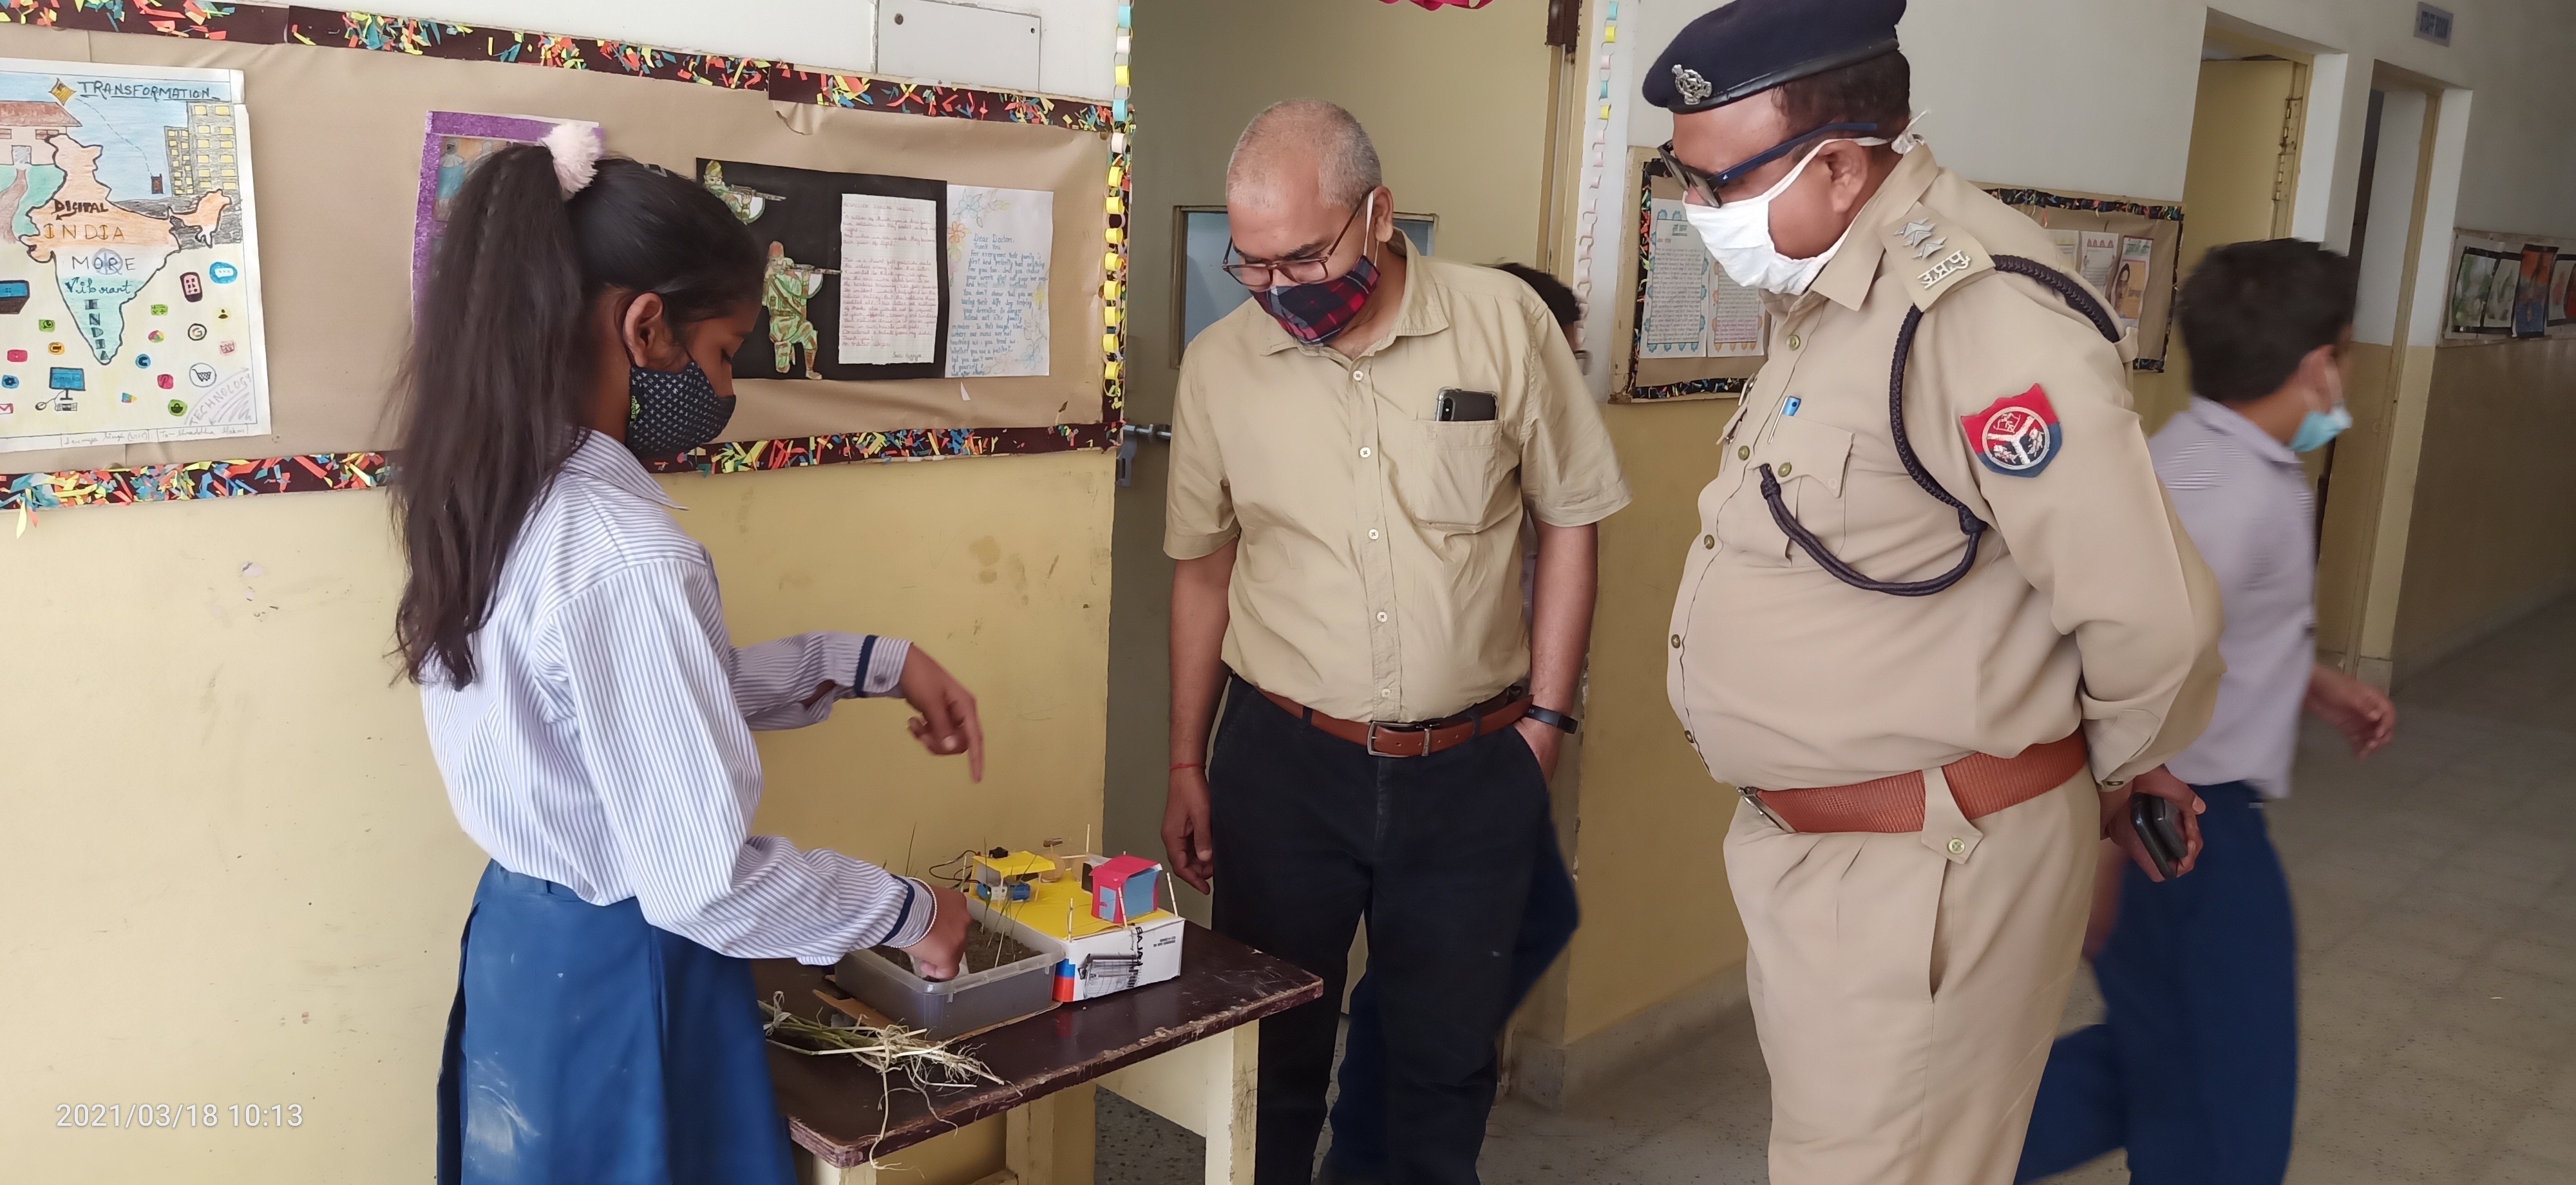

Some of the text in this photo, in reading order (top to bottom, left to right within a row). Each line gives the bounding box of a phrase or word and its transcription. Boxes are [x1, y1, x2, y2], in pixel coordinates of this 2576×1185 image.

[77, 81, 209, 101] TRANSFORMATION
[53, 199, 109, 216] DIGITAL
[43, 223, 125, 241] INDIA
[974, 233, 989, 242] Dear
[72, 256, 137, 275] MORE
[65, 277, 132, 294] Vibrant
[84, 299, 111, 360] INDIA
[189, 374, 252, 426] TECHNOLOGY
